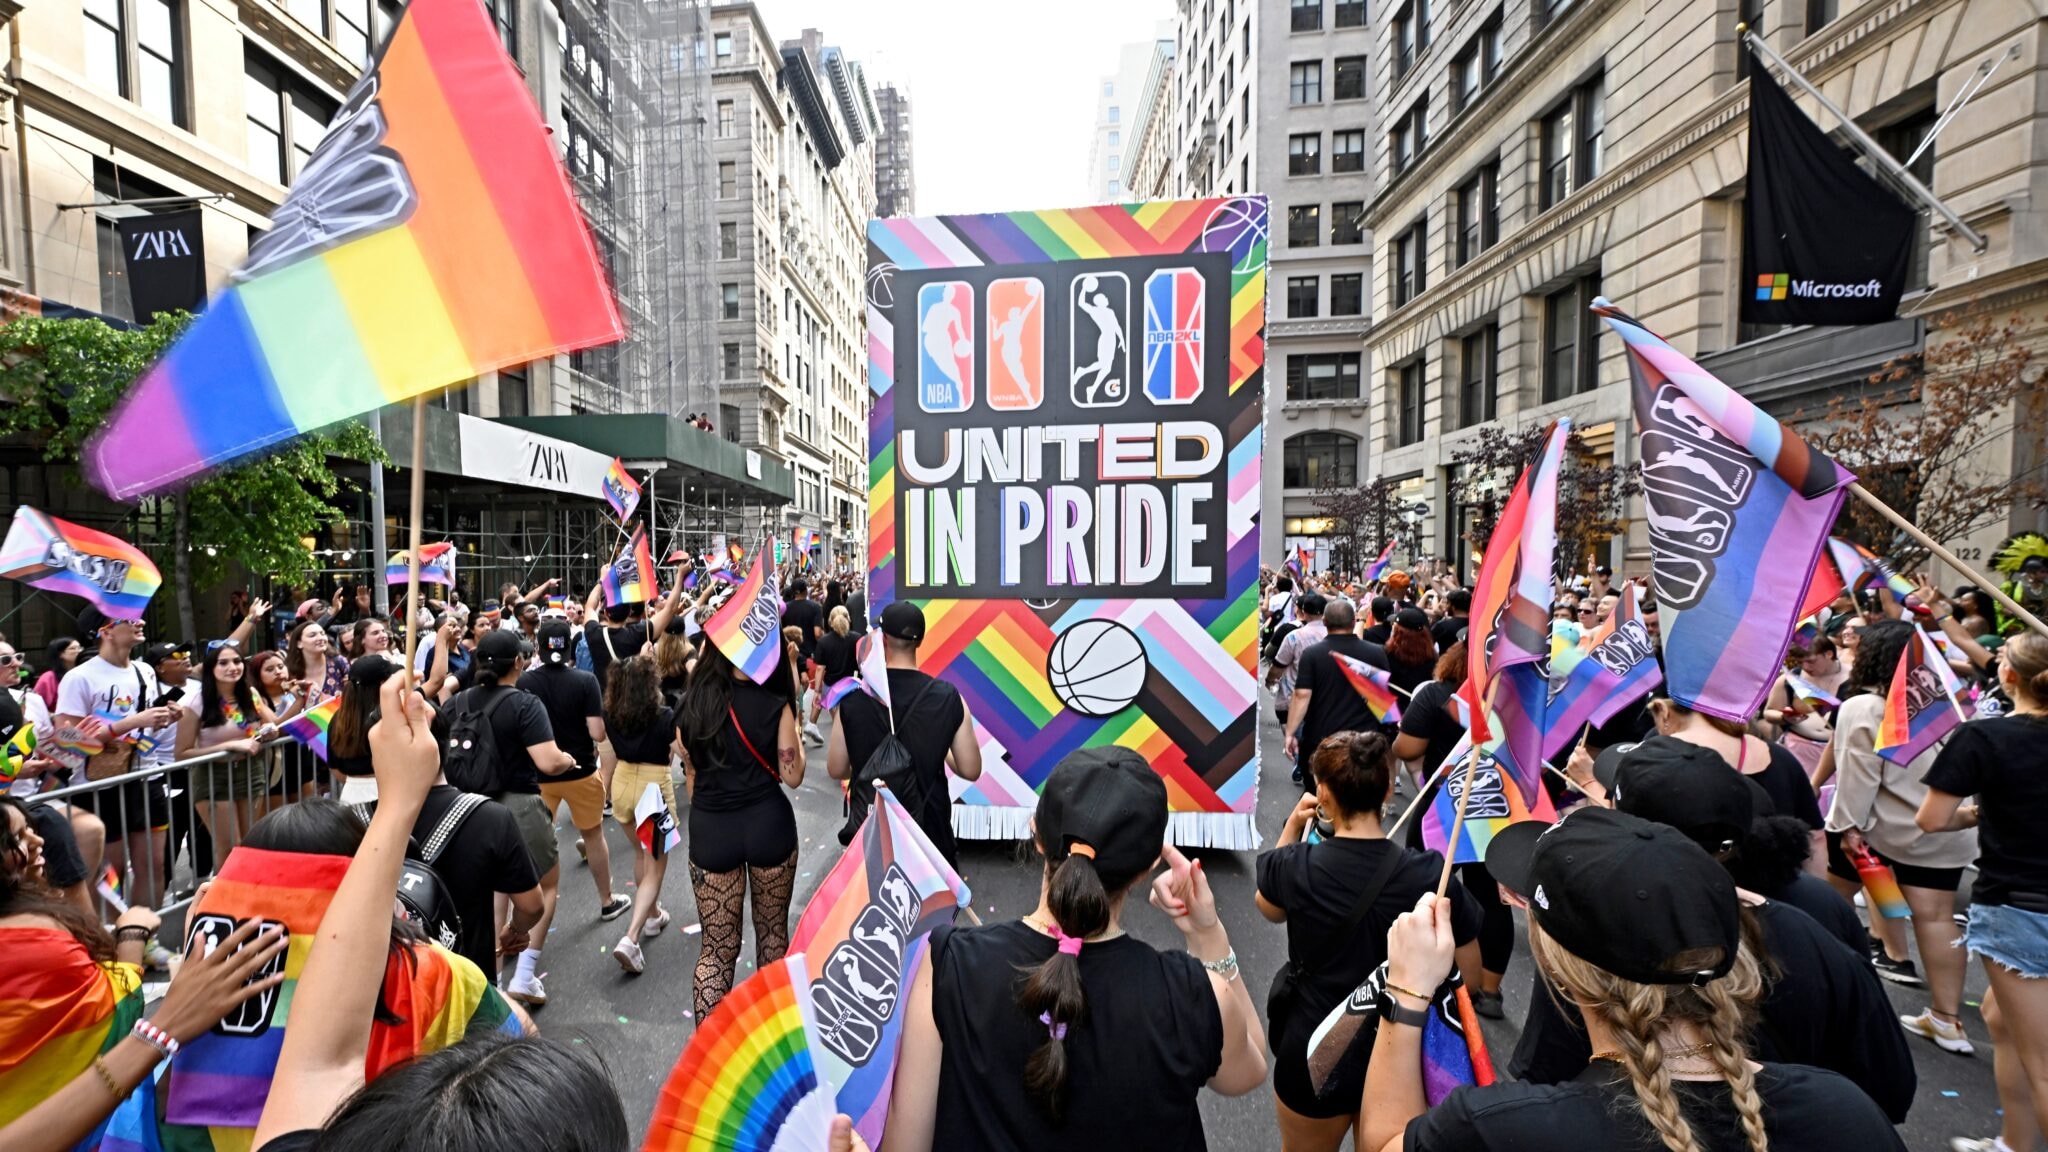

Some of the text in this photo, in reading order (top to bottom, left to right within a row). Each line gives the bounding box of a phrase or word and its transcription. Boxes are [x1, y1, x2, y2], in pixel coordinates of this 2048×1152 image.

[131, 229, 192, 260] ZARA
[1792, 279, 1881, 297] Microsoft
[927, 383, 953, 404] NBA
[993, 394, 1023, 402] WNBA
[528, 441, 568, 484] ZARA
[897, 421, 1224, 485] UNITED
[905, 482, 1213, 588] IN PRIDE
[1956, 548, 1981, 560] 122
[1355, 983, 1373, 1003] NBA
